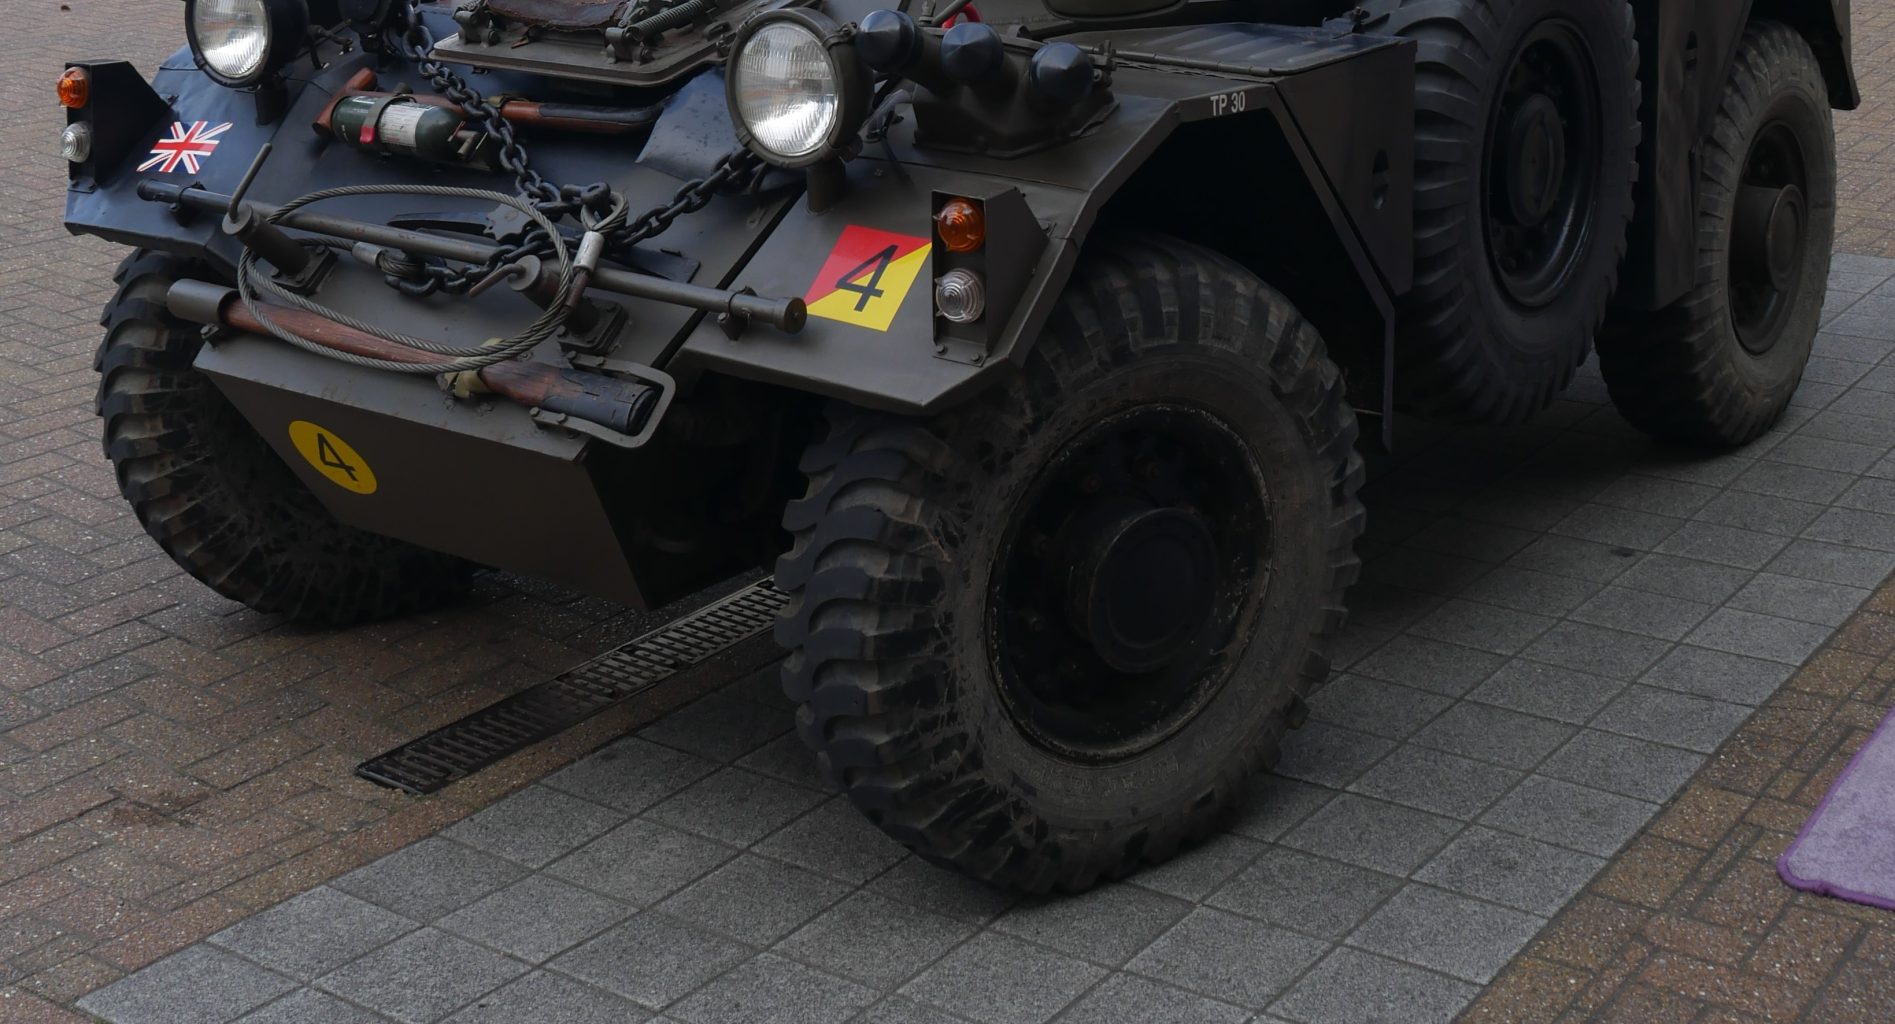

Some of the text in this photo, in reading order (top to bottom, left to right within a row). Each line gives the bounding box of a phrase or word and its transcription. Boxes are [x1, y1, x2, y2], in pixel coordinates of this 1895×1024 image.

[1210, 91, 1246, 116] TP 30
[835, 244, 898, 312] 4
[317, 432, 358, 482] 4
